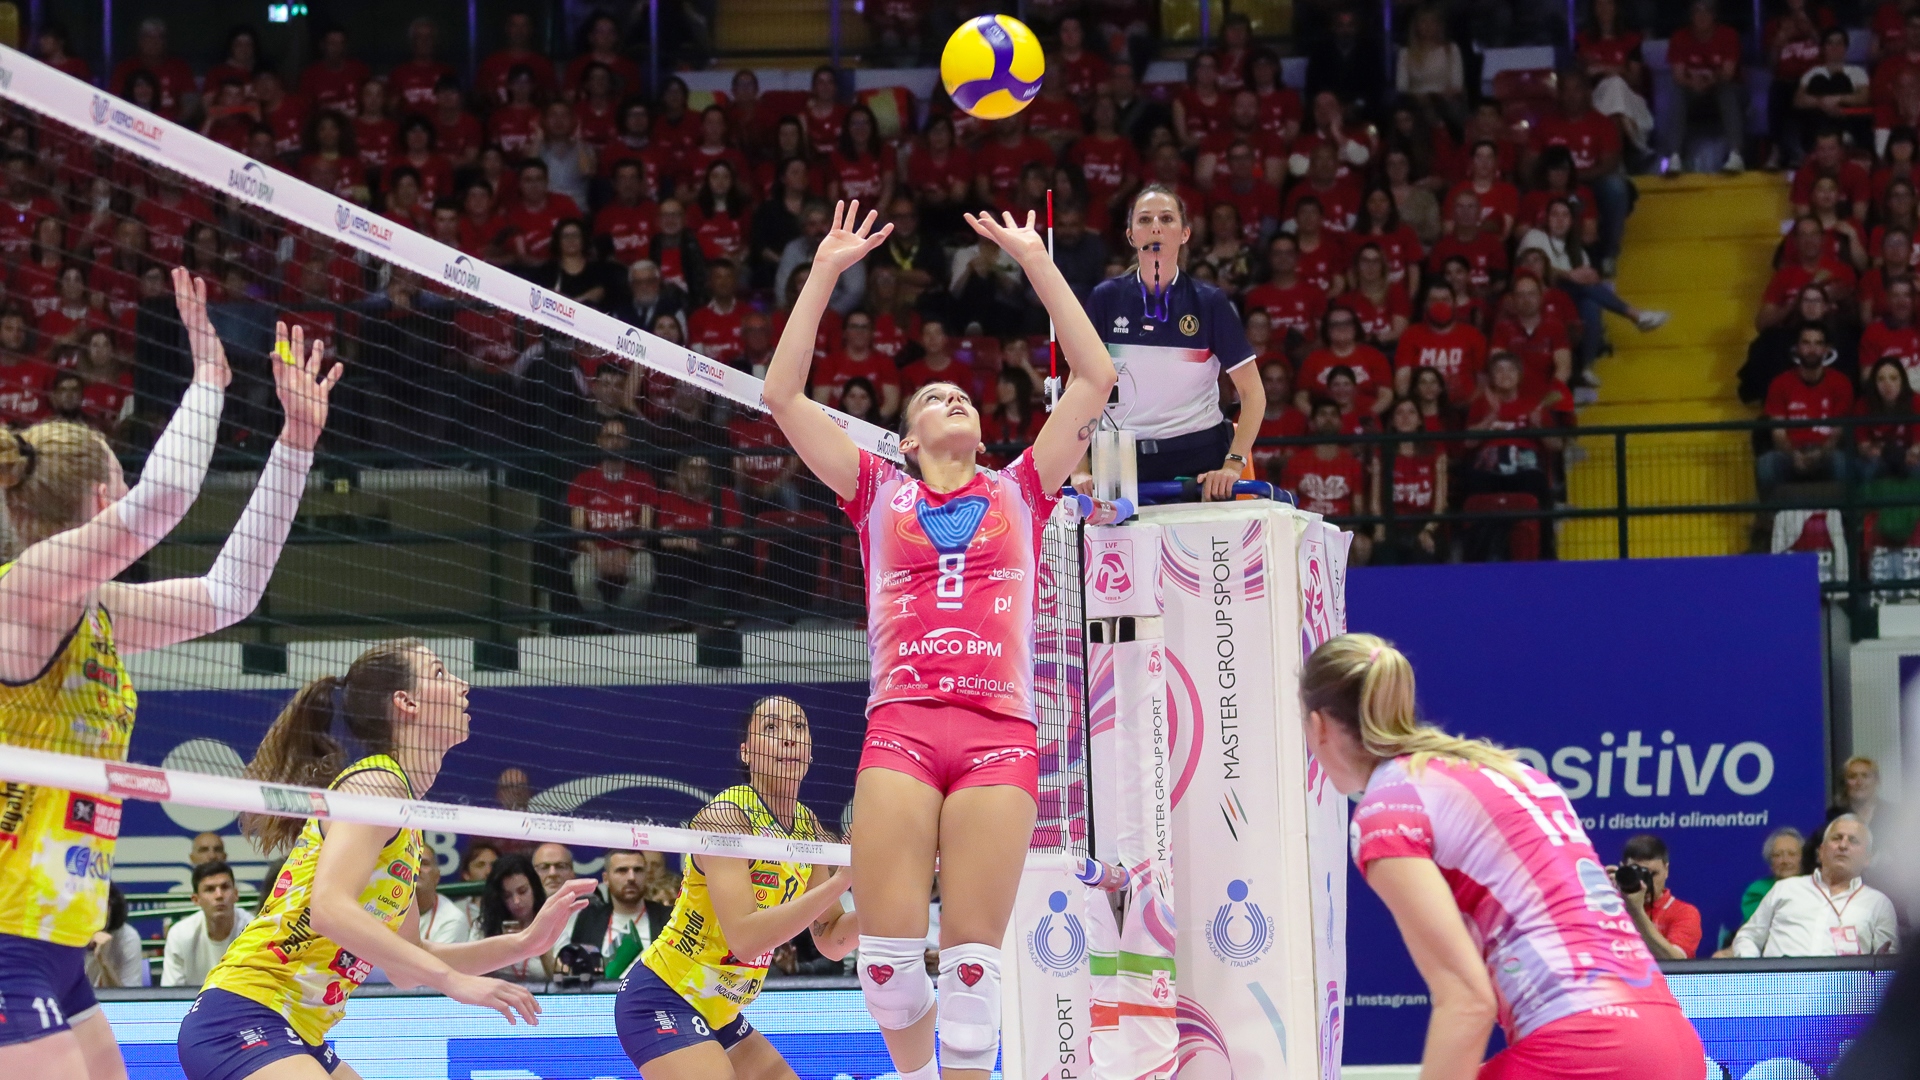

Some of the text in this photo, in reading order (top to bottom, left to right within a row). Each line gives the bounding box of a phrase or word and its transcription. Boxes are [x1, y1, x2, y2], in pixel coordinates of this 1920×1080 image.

[228, 169, 258, 198] BANCO
[443, 264, 480, 292] BANCO BPM
[542, 297, 576, 319] VEROVOLLEY
[616, 336, 636, 357] BANCO
[697, 361, 725, 381] VEROVOLLEY
[936, 553, 966, 598] 8
[992, 567, 1023, 582] telesia
[898, 639, 1002, 658] BANCO BPM
[1212, 536, 1240, 780] MASTER GROUP SPORT
[1152, 696, 1167, 861] MASTER GROUP SPORT
[1609, 812, 1676, 829] disturbi
[1678, 810, 1769, 828] alimentari
[1027, 930, 1048, 974] FEDERAZIONE
[1052, 966, 1080, 978] ITALIANA
[1205, 916, 1275, 968] FEDERAZIONE ITALIANA PALLAVOLO
[32, 997, 64, 1029] 11
[1356, 994, 1428, 1008] Instagram
[691, 1015, 710, 1036] 8
[1056, 993, 1076, 1064] SPORT
